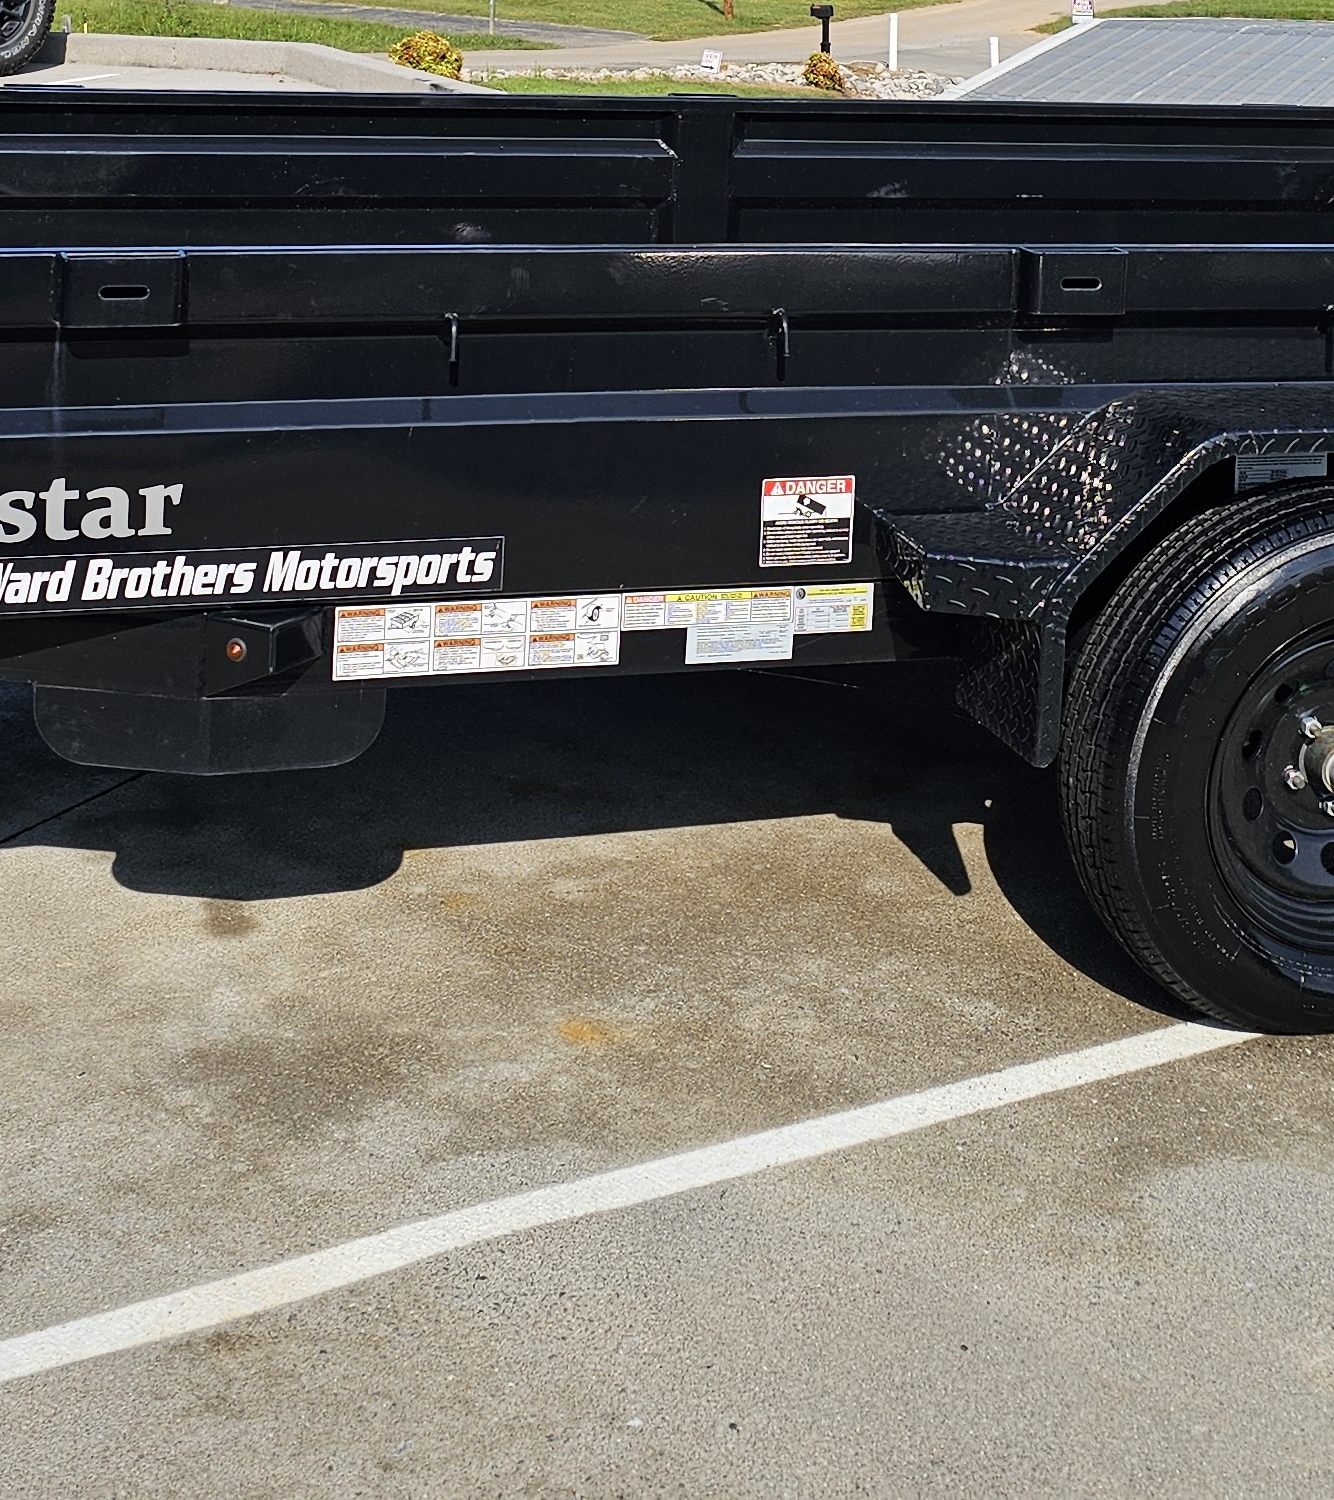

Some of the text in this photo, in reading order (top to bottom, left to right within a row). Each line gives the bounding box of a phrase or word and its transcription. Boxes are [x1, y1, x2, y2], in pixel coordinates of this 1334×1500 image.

[785, 479, 846, 495] DANGER
[81, 550, 257, 601] Brothers
[263, 546, 496, 596] Motorsports
[685, 594, 717, 602] CAUTION
[758, 590, 790, 598] WARNING
[442, 604, 477, 612] WARNING
[538, 600, 572, 608] WARNING
[346, 608, 381, 617] WARNING
[441, 638, 475, 646] WARNING
[537, 634, 571, 642] WARNING
[345, 643, 379, 652] WARNING
